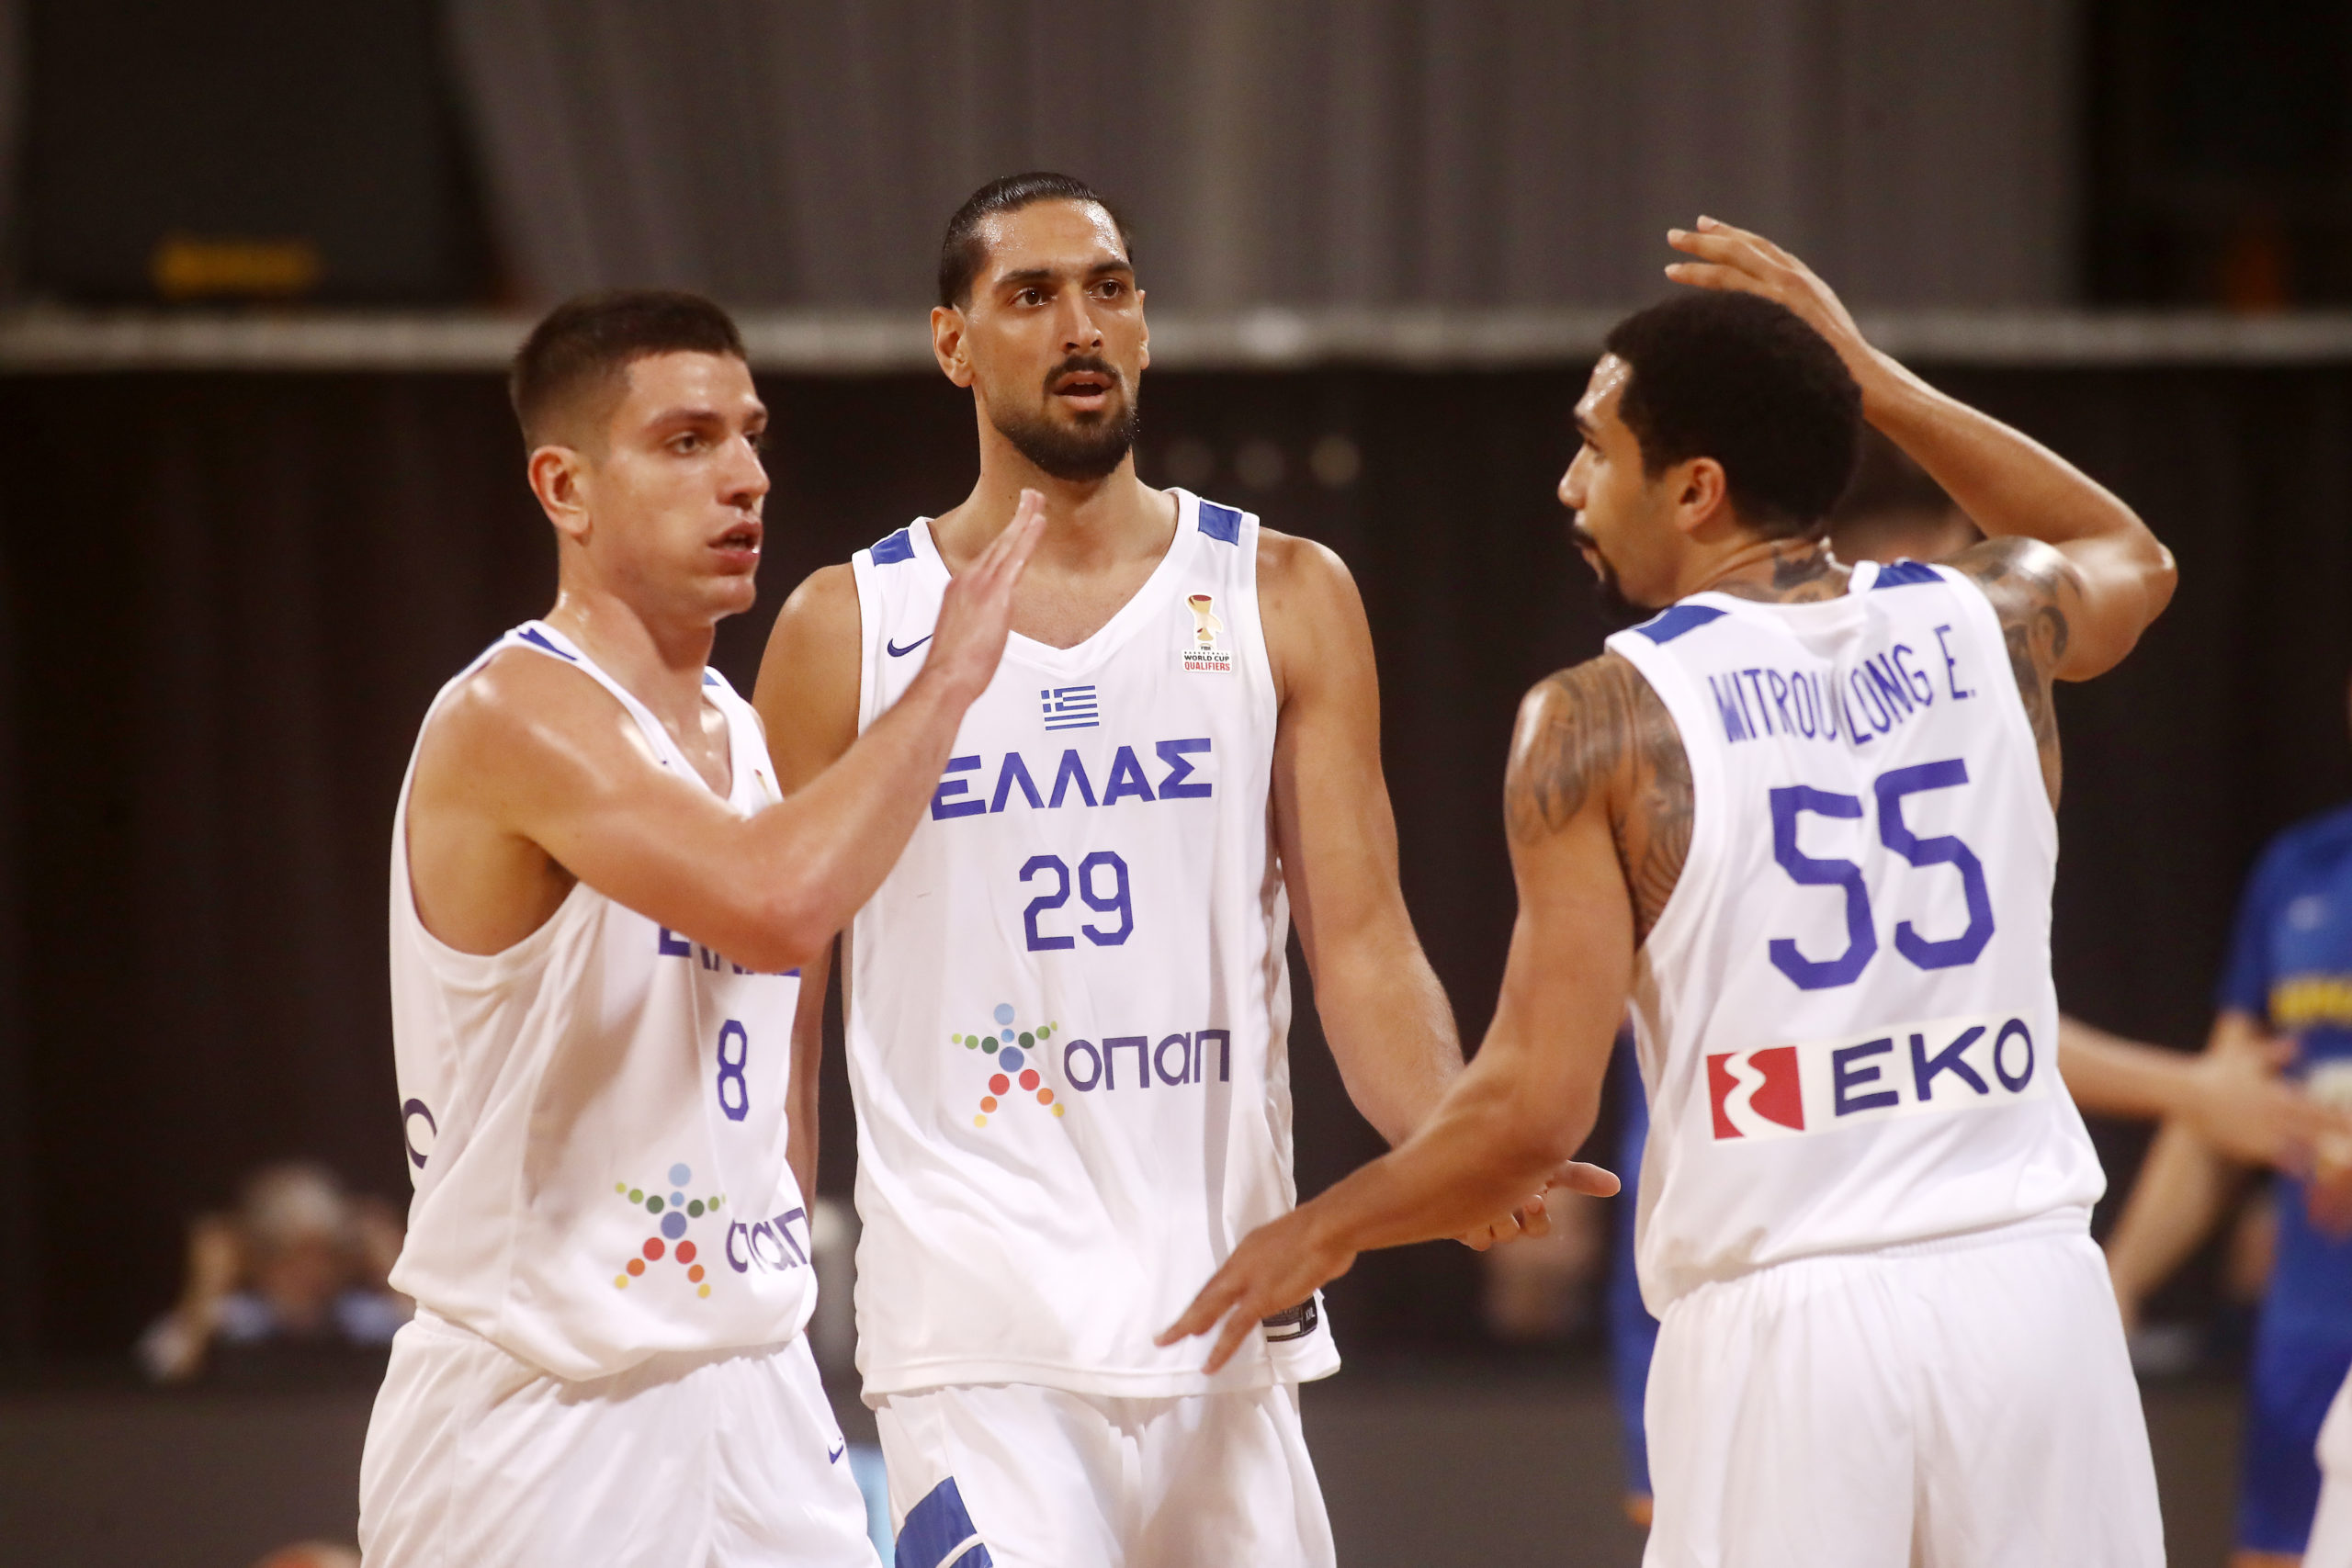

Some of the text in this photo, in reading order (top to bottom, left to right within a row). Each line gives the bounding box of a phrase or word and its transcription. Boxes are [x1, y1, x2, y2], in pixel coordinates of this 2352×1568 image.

[1184, 661, 1231, 671] QUALIFIERS
[1934, 624, 1976, 700] E.
[930, 738, 1213, 821] ΕΛΛΑΣ
[1019, 851, 1134, 952] 29
[1770, 758, 1996, 991] 55
[718, 1019, 750, 1122] 8
[1832, 1018, 2035, 1118] EKO
